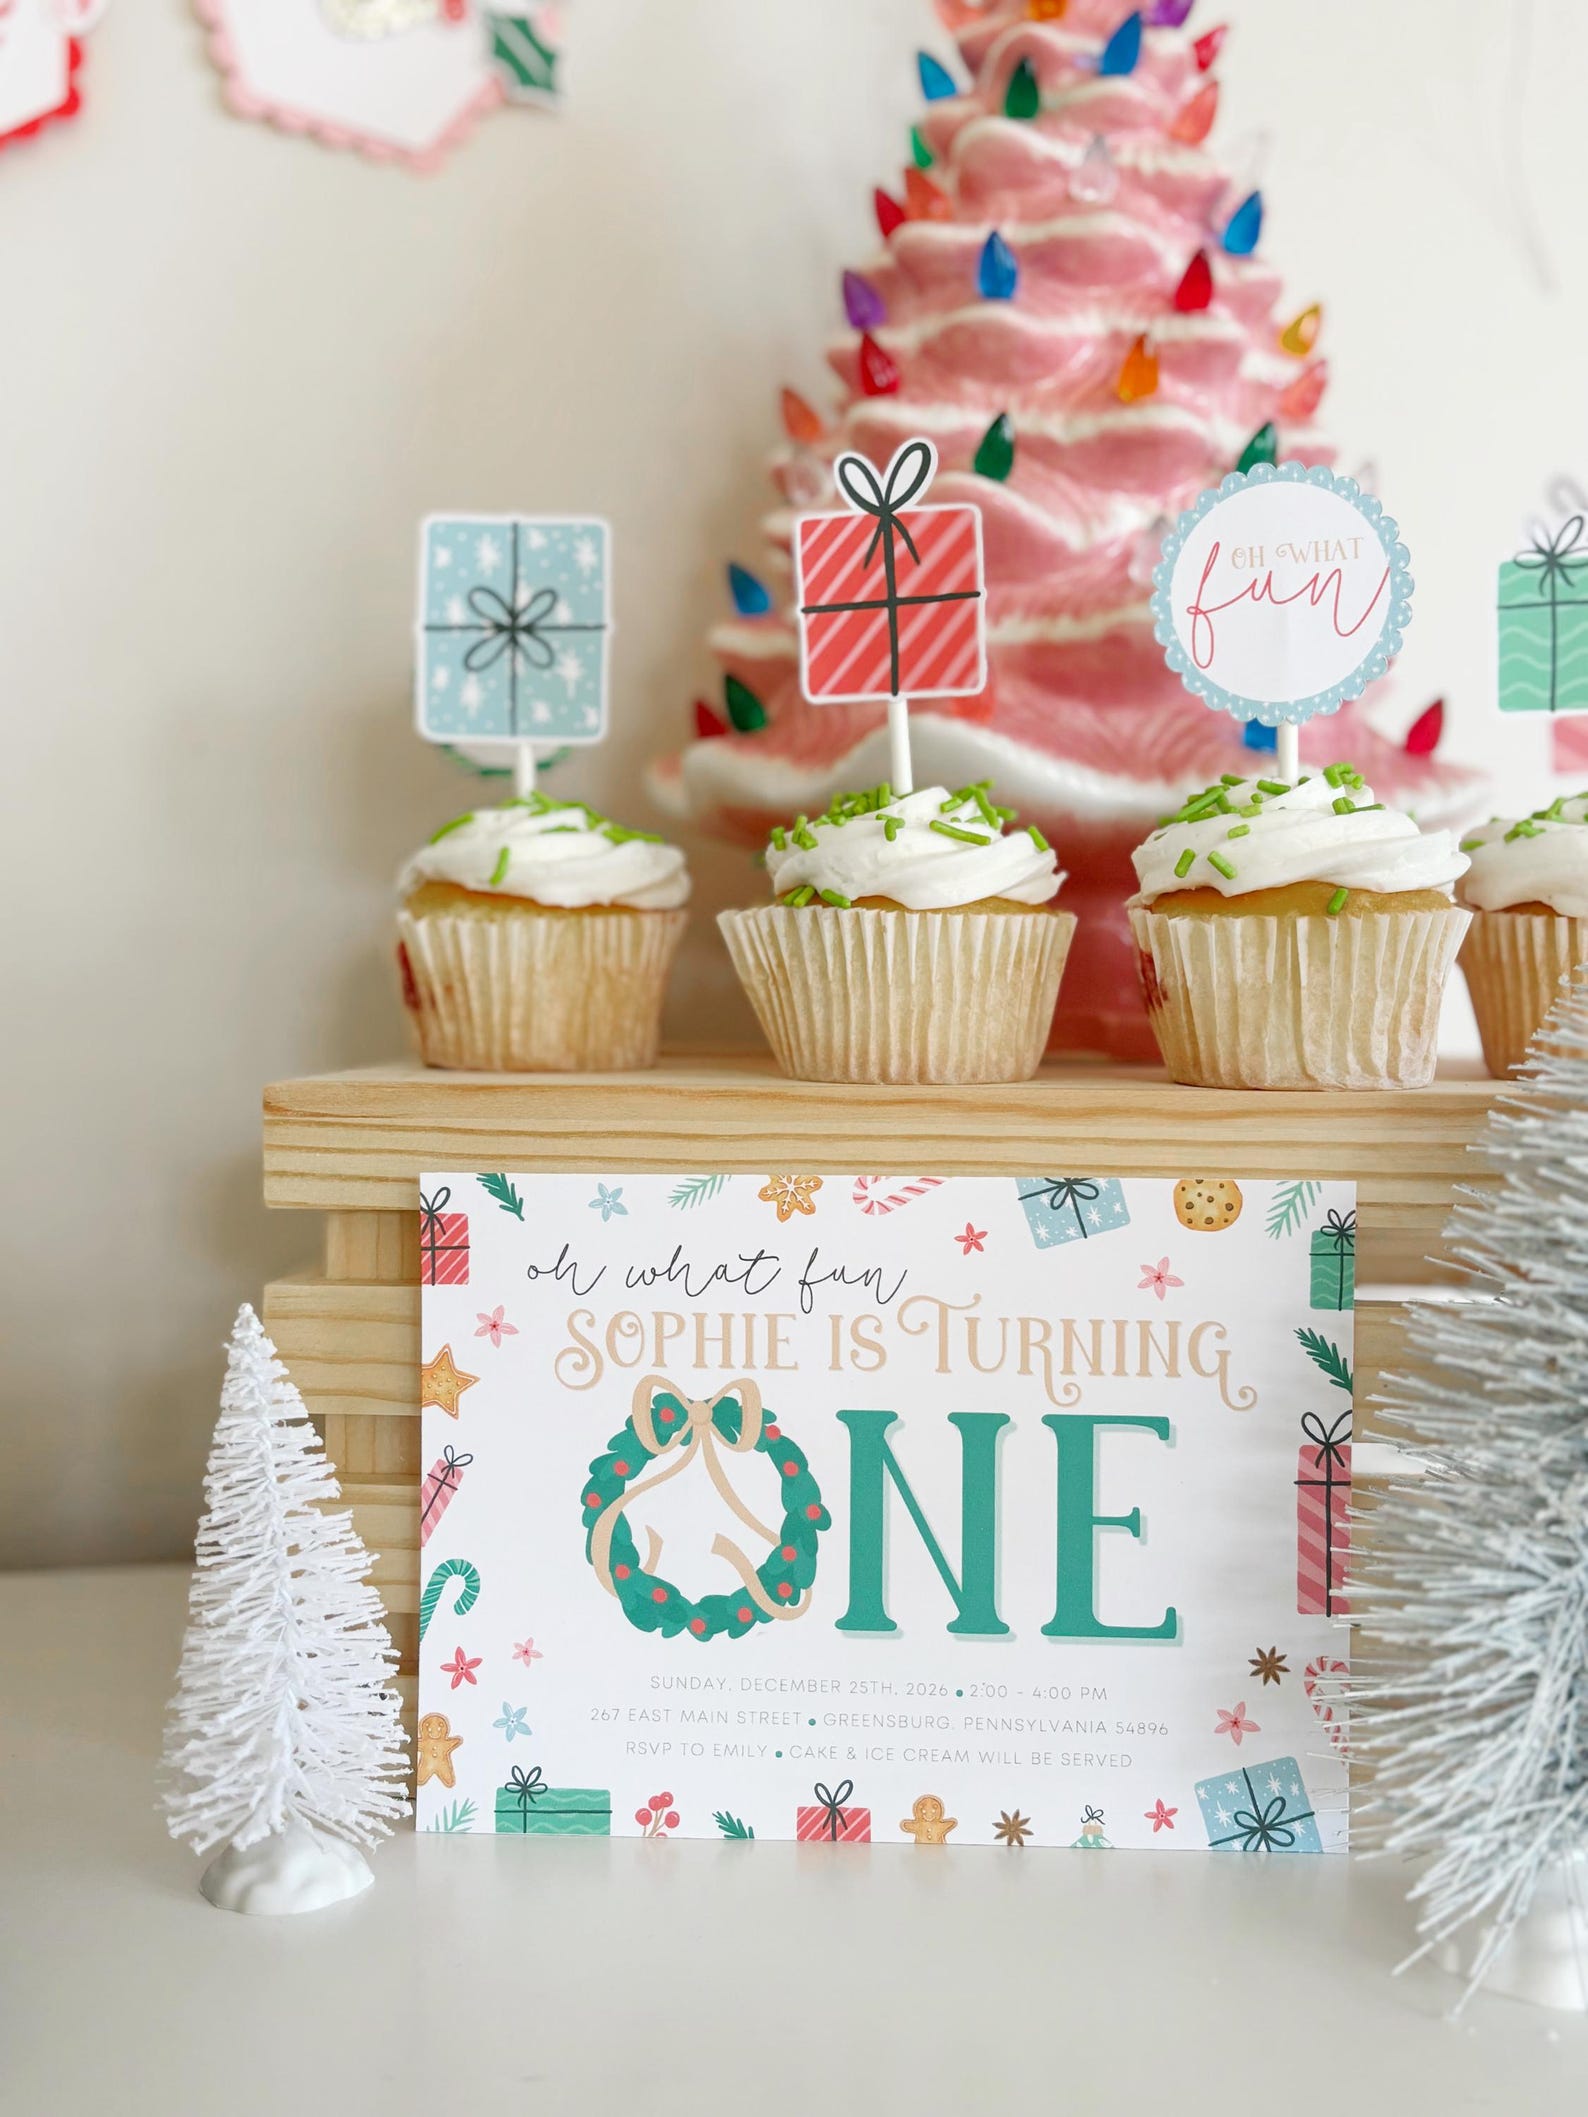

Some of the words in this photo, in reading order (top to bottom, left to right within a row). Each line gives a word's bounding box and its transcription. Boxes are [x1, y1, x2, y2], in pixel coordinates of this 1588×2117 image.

[1231, 545, 1265, 570] OH
[1275, 537, 1364, 565] WHAT
[1186, 541, 1390, 669] fun
[527, 1243, 607, 1296] oh
[626, 1244, 781, 1297] what
[798, 1247, 908, 1314] fun
[554, 1308, 799, 1391] SOPHIE
[828, 1313, 888, 1372] IS
[897, 1293, 1258, 1411] TURNING
[740, 1677, 841, 1694] DECEMBER
[906, 1682, 948, 1697] 2026
[1032, 1686, 1072, 1700] 4:00
[1080, 1686, 1108, 1701] PM
[590, 1708, 620, 1722] 267
[628, 1708, 673, 1723] EAST
[680, 1710, 729, 1725] MAIN
[737, 1710, 801, 1726] STREET
[963, 1716, 1107, 1735] PENNSYLVANIA
[1115, 1721, 1169, 1737] 54896
[626, 1741, 673, 1756] RSVP
[680, 1743, 705, 1757] TO
[713, 1743, 768, 1759] EMILY
[789, 1745, 838, 1761] CAKE
[846, 1747, 856, 1762] &
[865, 1748, 895, 1762] ICE
[903, 1748, 969, 1764] CREAM
[978, 1751, 1022, 1766] WILL
[1031, 1751, 1052, 1767] BE
[1060, 1752, 1133, 1769] SERVED
